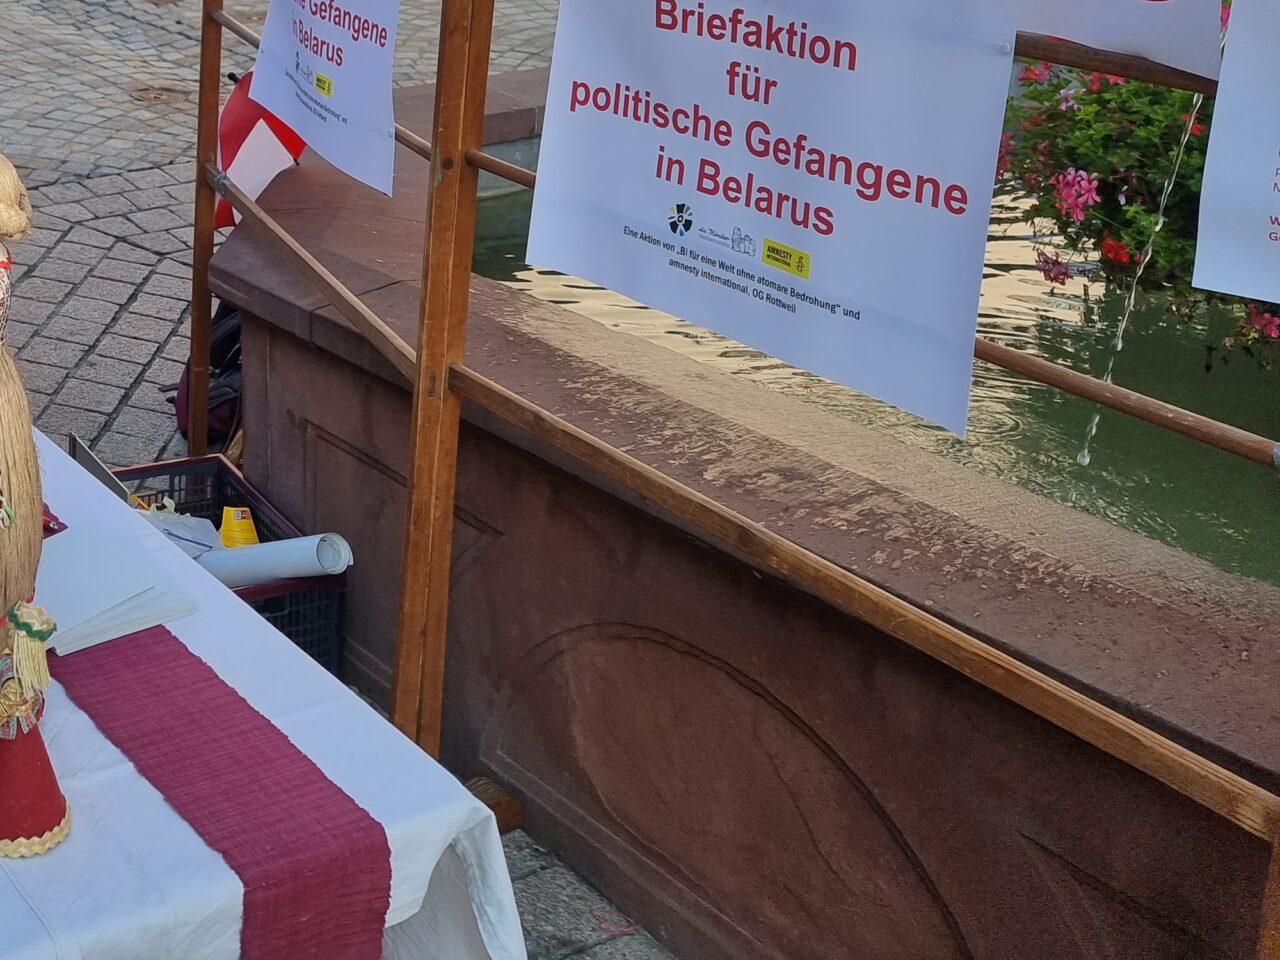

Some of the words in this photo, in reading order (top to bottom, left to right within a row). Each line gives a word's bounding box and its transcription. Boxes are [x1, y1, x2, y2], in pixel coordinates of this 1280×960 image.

[299, 18, 344, 67] Belarus
[727, 60, 778, 105] für
[569, 80, 733, 146] politische
[745, 120, 969, 216] Gefangene
[656, 146, 686, 185] in
[696, 158, 834, 236] Belarus
[623, 226, 638, 238] Eine
[639, 231, 661, 247] Aktion
[662, 241, 675, 252] von
[689, 249, 700, 261] für
[701, 255, 717, 267] eine
[718, 259, 735, 275] Welt
[736, 267, 756, 282] ohne
[757, 276, 789, 294] atomare
[843, 307, 861, 320] und
[767, 245, 793, 261] AMNESTY
[669, 258, 700, 277] amnesty
[700, 268, 751, 296] international,
[752, 288, 764, 300] OG
[765, 293, 797, 314] Rottweil
